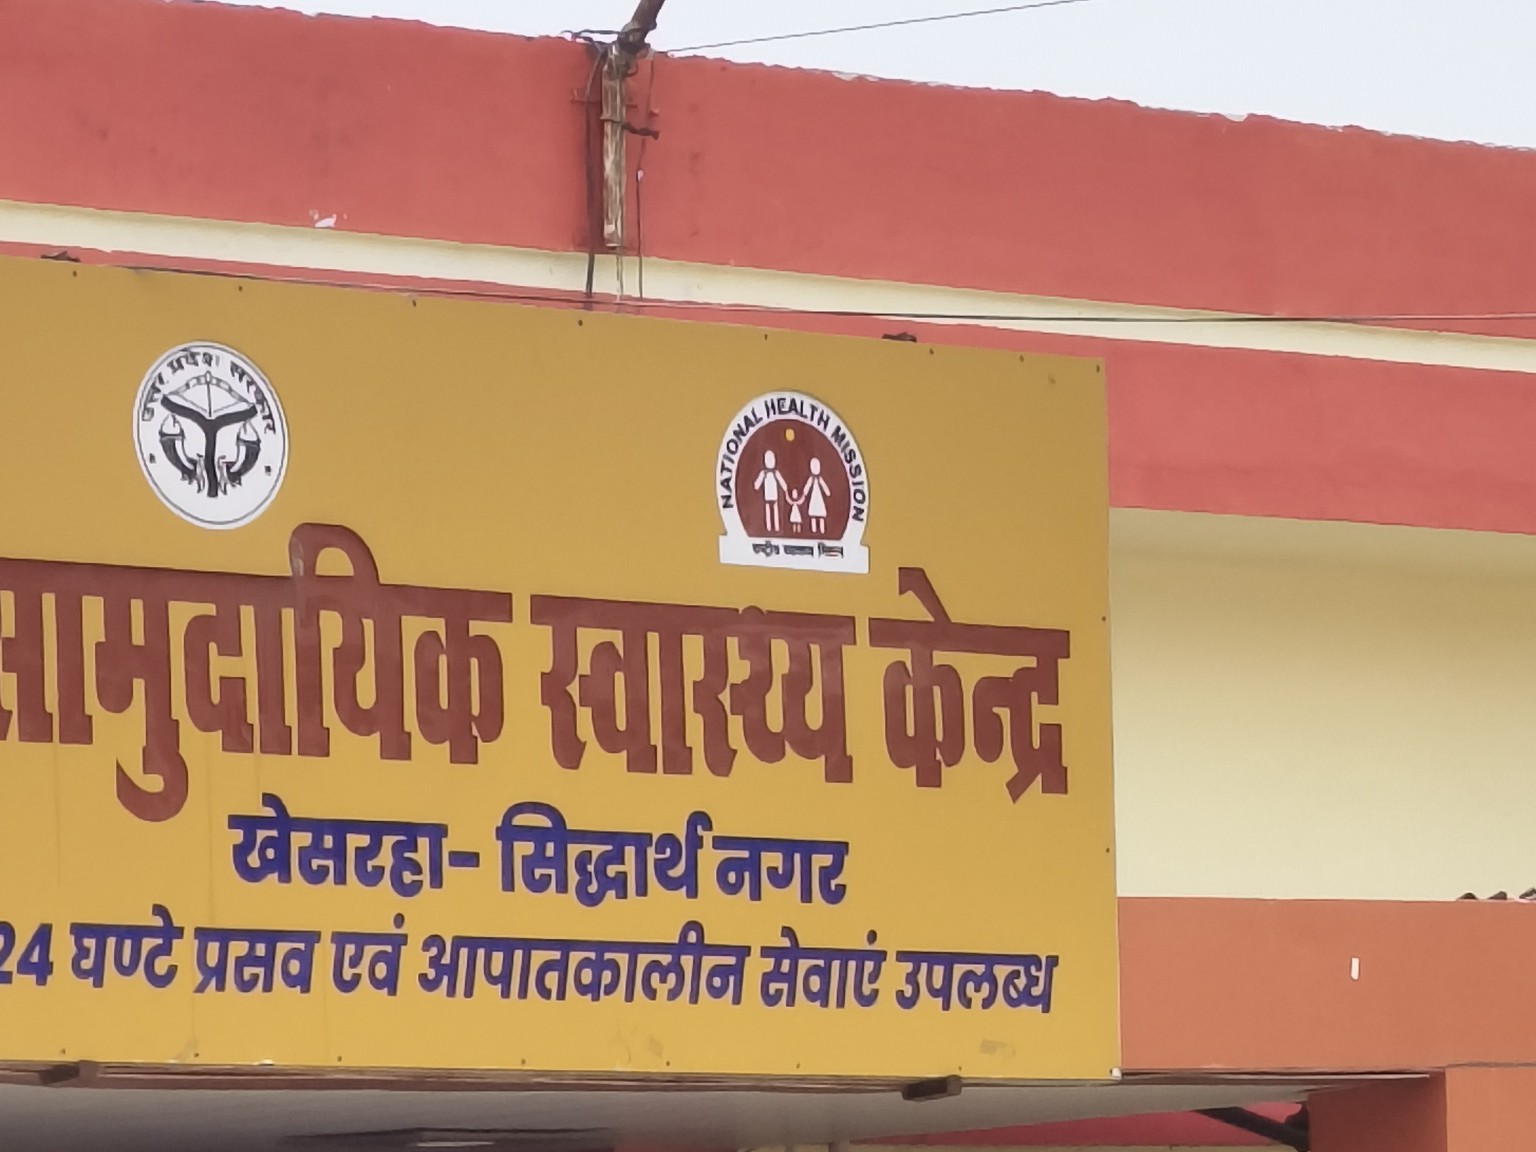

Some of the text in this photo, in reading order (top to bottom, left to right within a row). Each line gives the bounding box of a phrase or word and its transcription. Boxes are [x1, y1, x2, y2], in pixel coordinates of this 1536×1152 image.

[720, 397, 866, 522] NATIONAL HEALTH MISSION
[530, 593, 857, 784] स्वास्थ्य
[868, 566, 1071, 804] केन्द्र
[495, 800, 713, 907] सिद्धार्थ
[712, 833, 850, 905] नगर
[70, 903, 185, 989] घण्टे
[193, 926, 322, 994] प्रसव
[330, 912, 409, 997] एवं
[418, 919, 752, 1006] आपातकालीन
[760, 925, 887, 1010] सेवाएं
[895, 950, 1060, 1014] उपलब्ध
